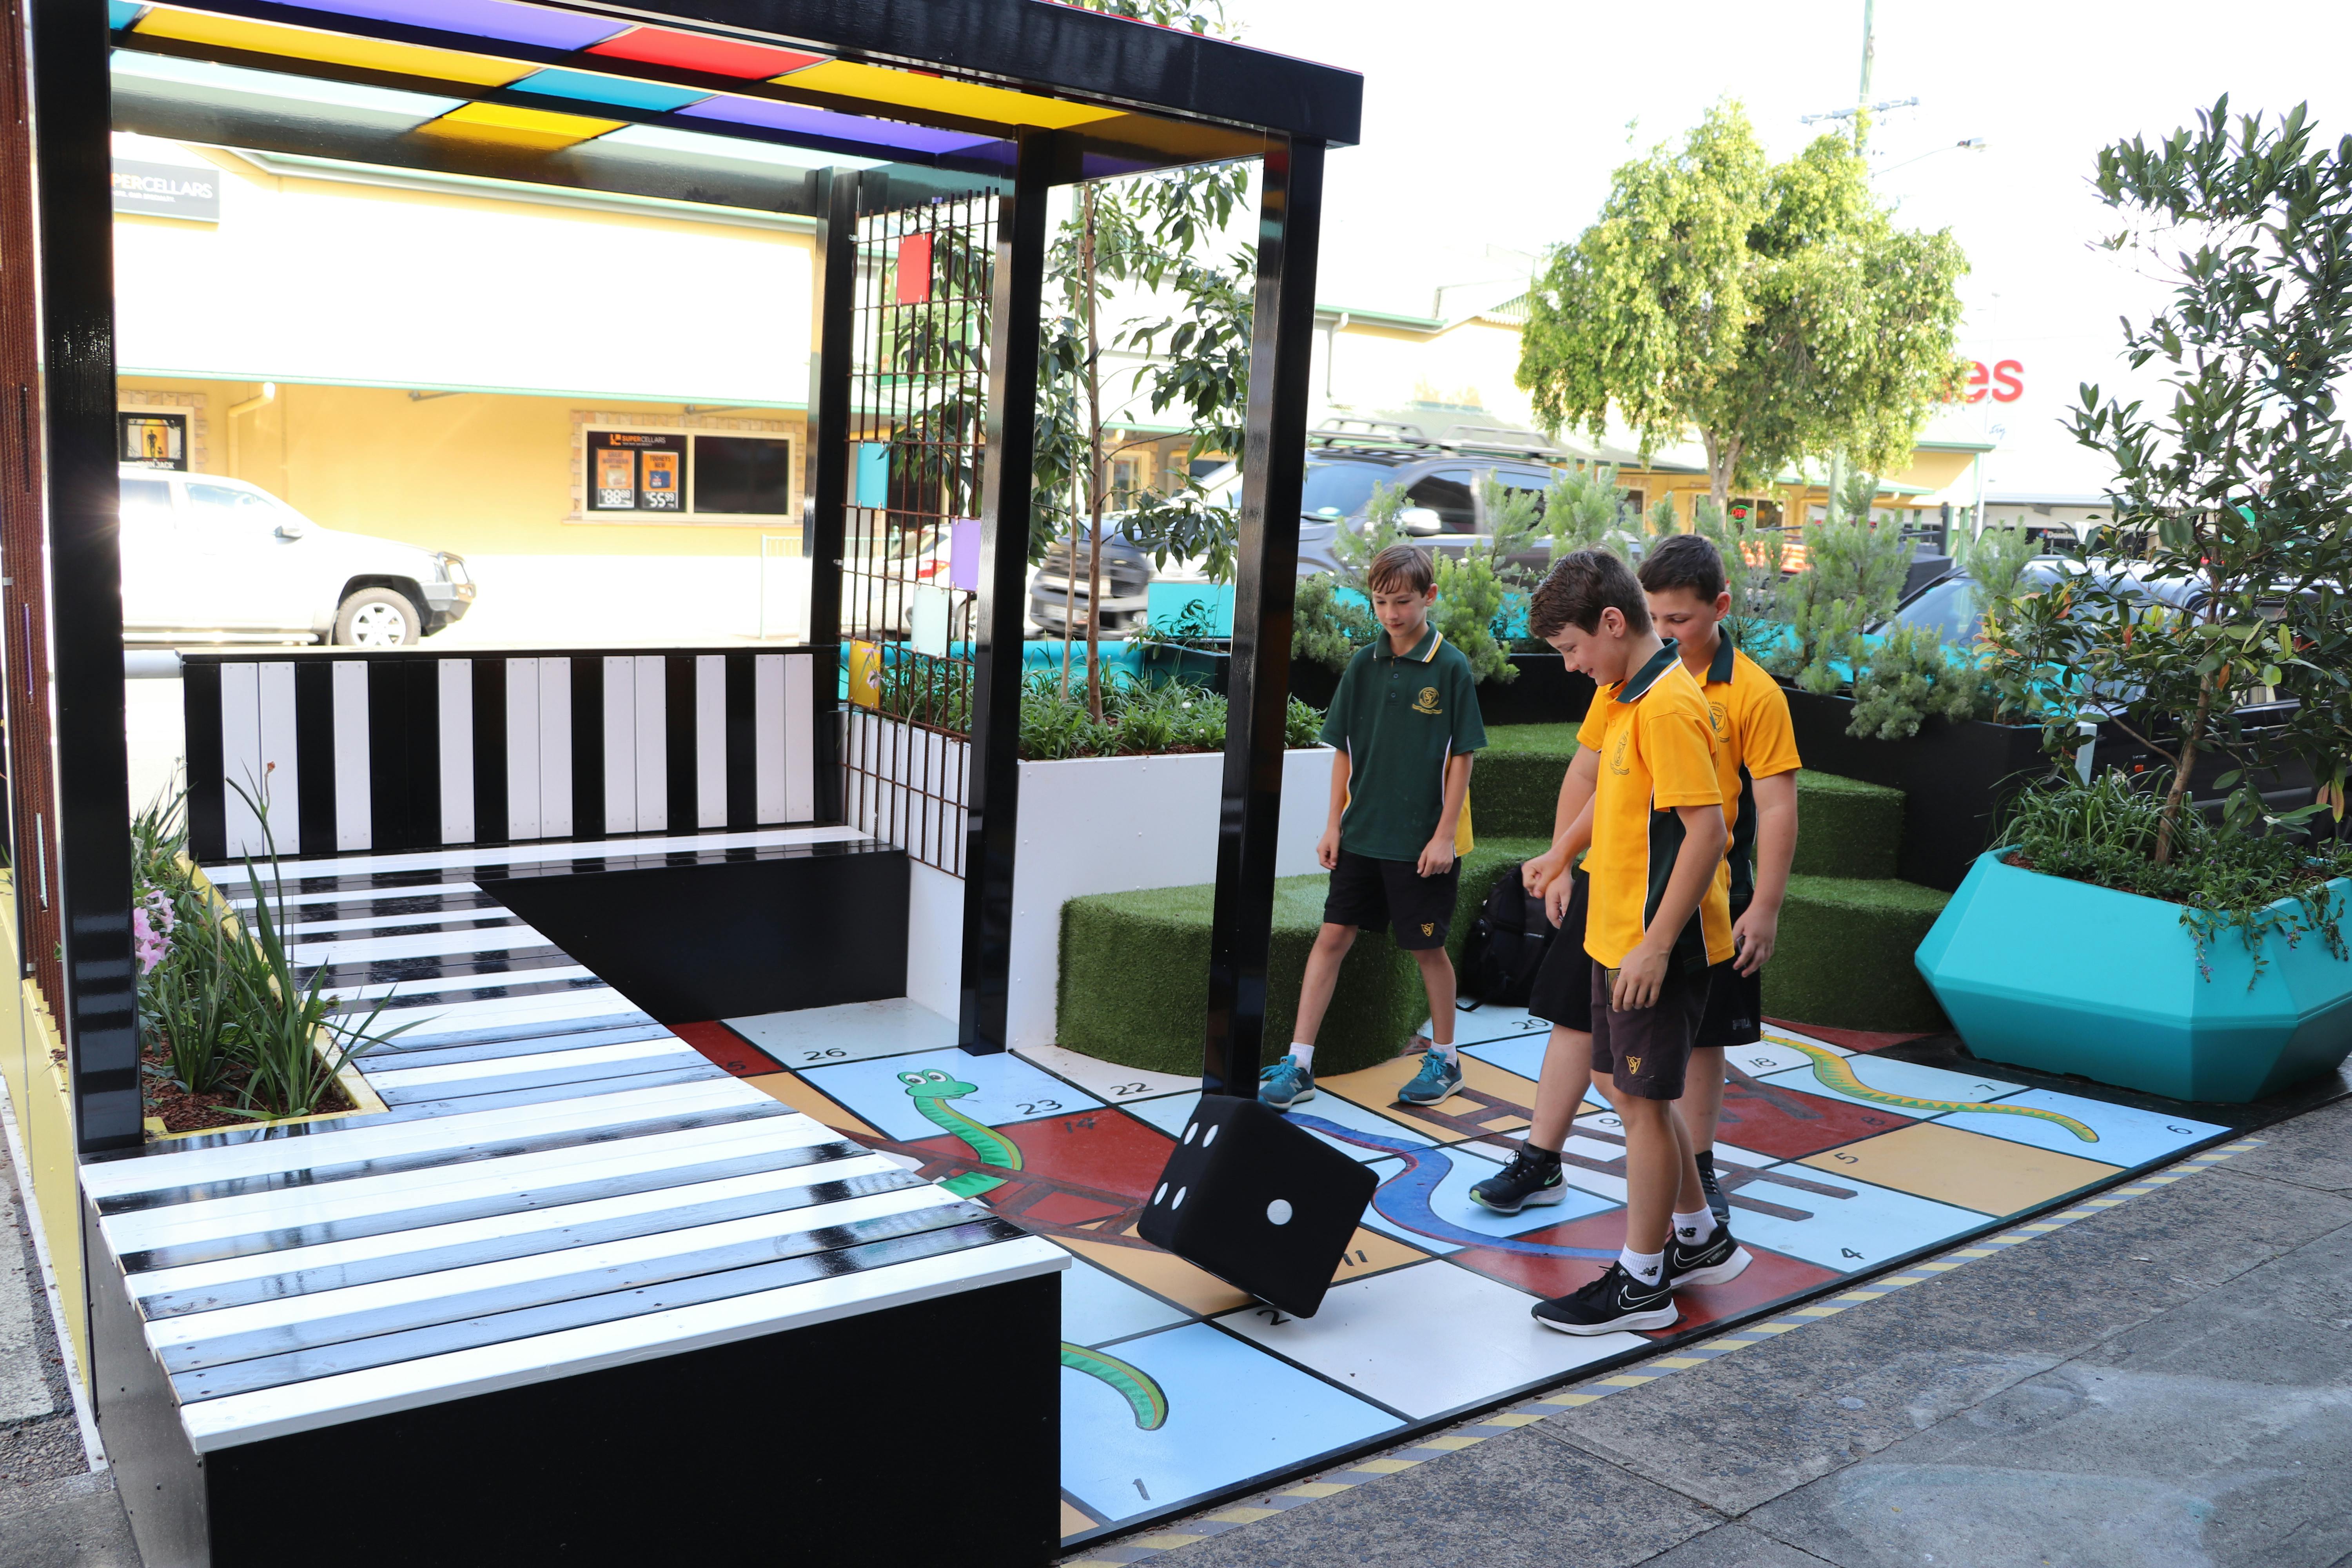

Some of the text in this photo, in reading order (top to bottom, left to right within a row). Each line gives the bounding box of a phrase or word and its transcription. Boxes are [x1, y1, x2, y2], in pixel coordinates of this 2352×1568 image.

[111, 173, 213, 198] PERCELLARS
[622, 436, 666, 444] SUPERCELLARS
[156, 461, 175, 469] JACK
[2047, 530, 2076, 539] Domin
[1511, 1018, 1549, 1030] 20
[803, 1048, 846, 1061] 26
[1749, 1058, 1777, 1069] 18
[1111, 1082, 1154, 1096] 22
[1016, 1099, 1063, 1115] 23
[1064, 1117, 1097, 1134] 14
[1599, 1118, 1622, 1128] 9
[1860, 1116, 1886, 1126] 8
[2167, 1125, 2193, 1134] 6
[1834, 1152, 1859, 1164] 5
[1342, 1250, 1368, 1267] 11
[1841, 1247, 1866, 1259] 4
[1256, 1309, 1292, 1325] 2
[1132, 1478, 1151, 1501] 1
